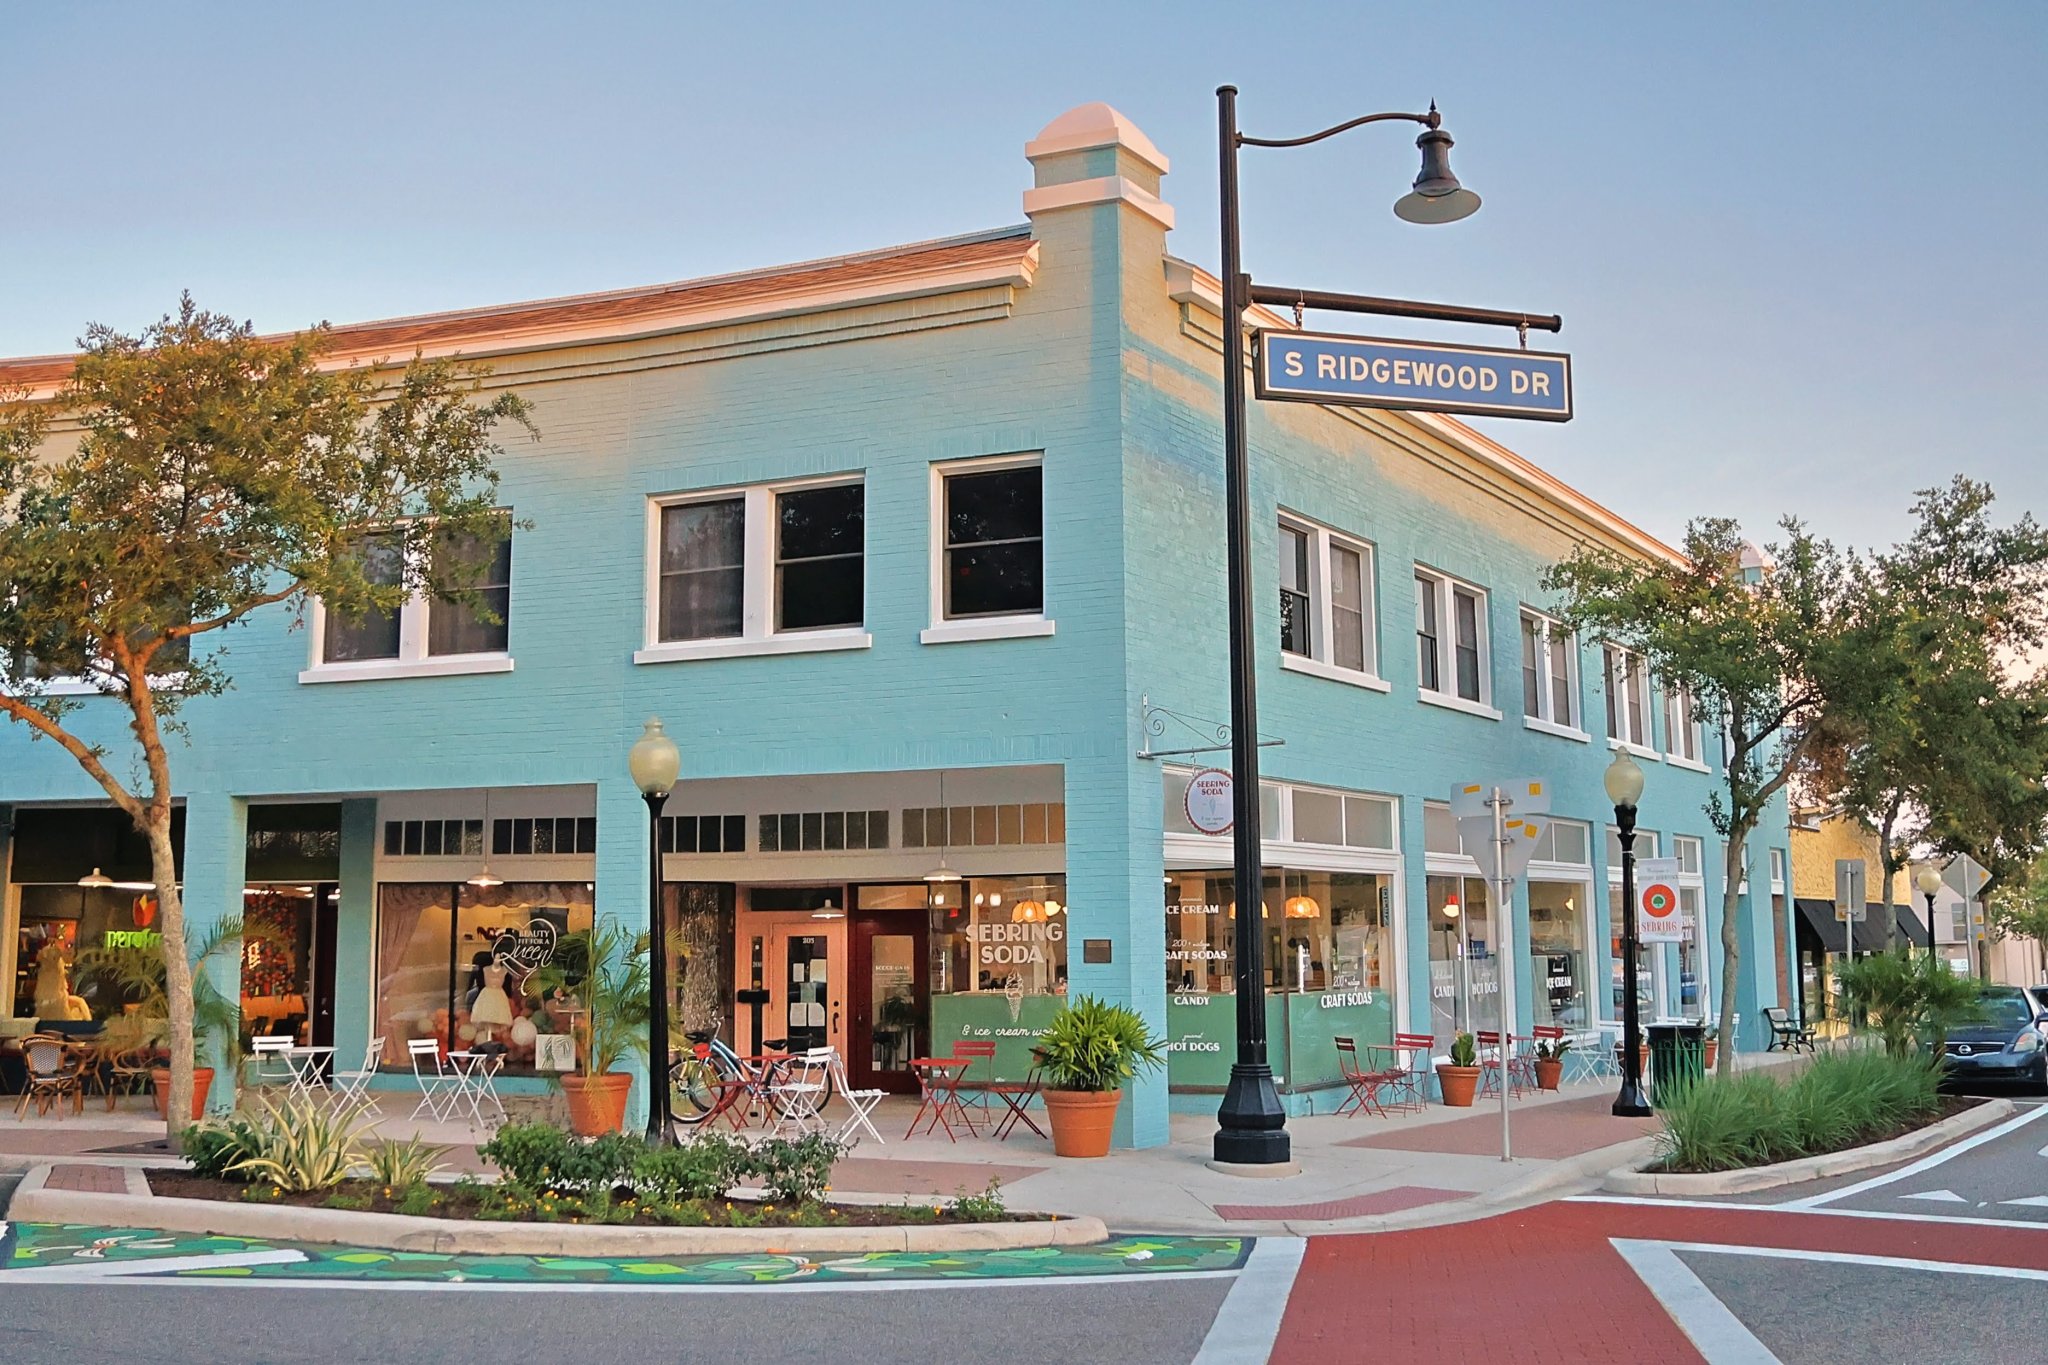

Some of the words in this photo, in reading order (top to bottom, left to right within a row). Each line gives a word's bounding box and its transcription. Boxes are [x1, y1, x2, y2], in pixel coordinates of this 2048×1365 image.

[1285, 351, 1303, 376] S
[1317, 354, 1498, 392] RIDGEWOOD
[1511, 370, 1550, 396] DR
[1196, 780, 1230, 788] SEBRING
[1201, 788, 1223, 796] SODA
[1166, 905, 1179, 914] CE
[1181, 904, 1219, 914] CREAM
[965, 922, 1063, 942] SEBRING
[1641, 921, 1677, 932] SEBRING
[519, 929, 550, 938] BEAUTY
[491, 934, 553, 970] Queen
[980, 945, 1044, 964] SODA
[1165, 951, 1190, 960] RAFT
[1191, 950, 1228, 960] SODAS
[1433, 985, 1455, 998] CANDY
[1173, 996, 1210, 1005] CANDY
[1321, 993, 1346, 1009] CRAFT
[1347, 991, 1373, 1006] SODAS
[961, 1024, 970, 1036] &
[974, 1027, 991, 1036] ice
[995, 1028, 1030, 1037] cream
[1189, 1042, 1220, 1051] DOGS
